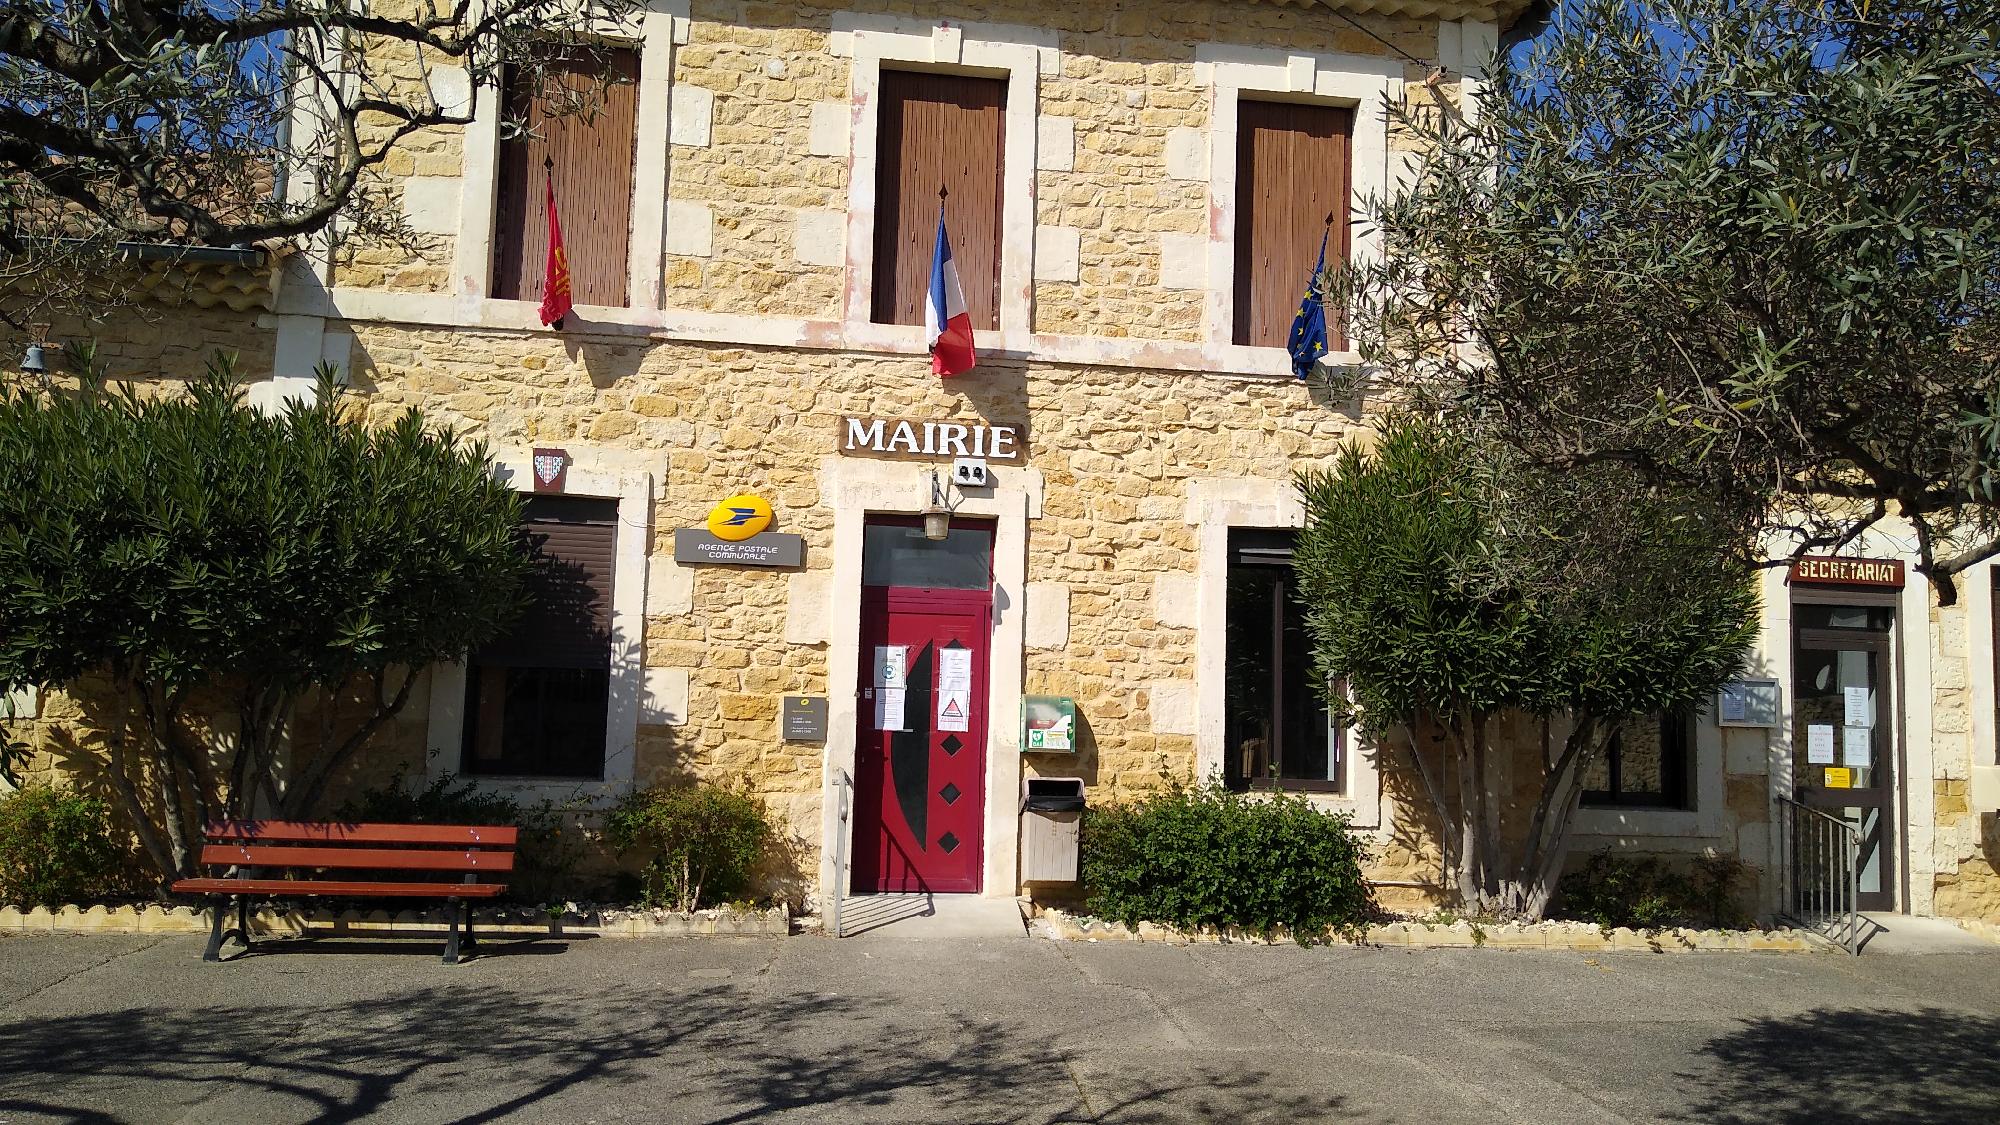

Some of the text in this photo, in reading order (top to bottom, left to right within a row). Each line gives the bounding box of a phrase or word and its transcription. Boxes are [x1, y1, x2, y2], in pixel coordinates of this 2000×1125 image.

[845, 418, 1017, 458] MAIRIE
[698, 543, 779, 554] AGENCE POSTALE
[708, 551, 767, 560] COMMUNALE
[1799, 560, 1896, 582] SECRETARIAT
